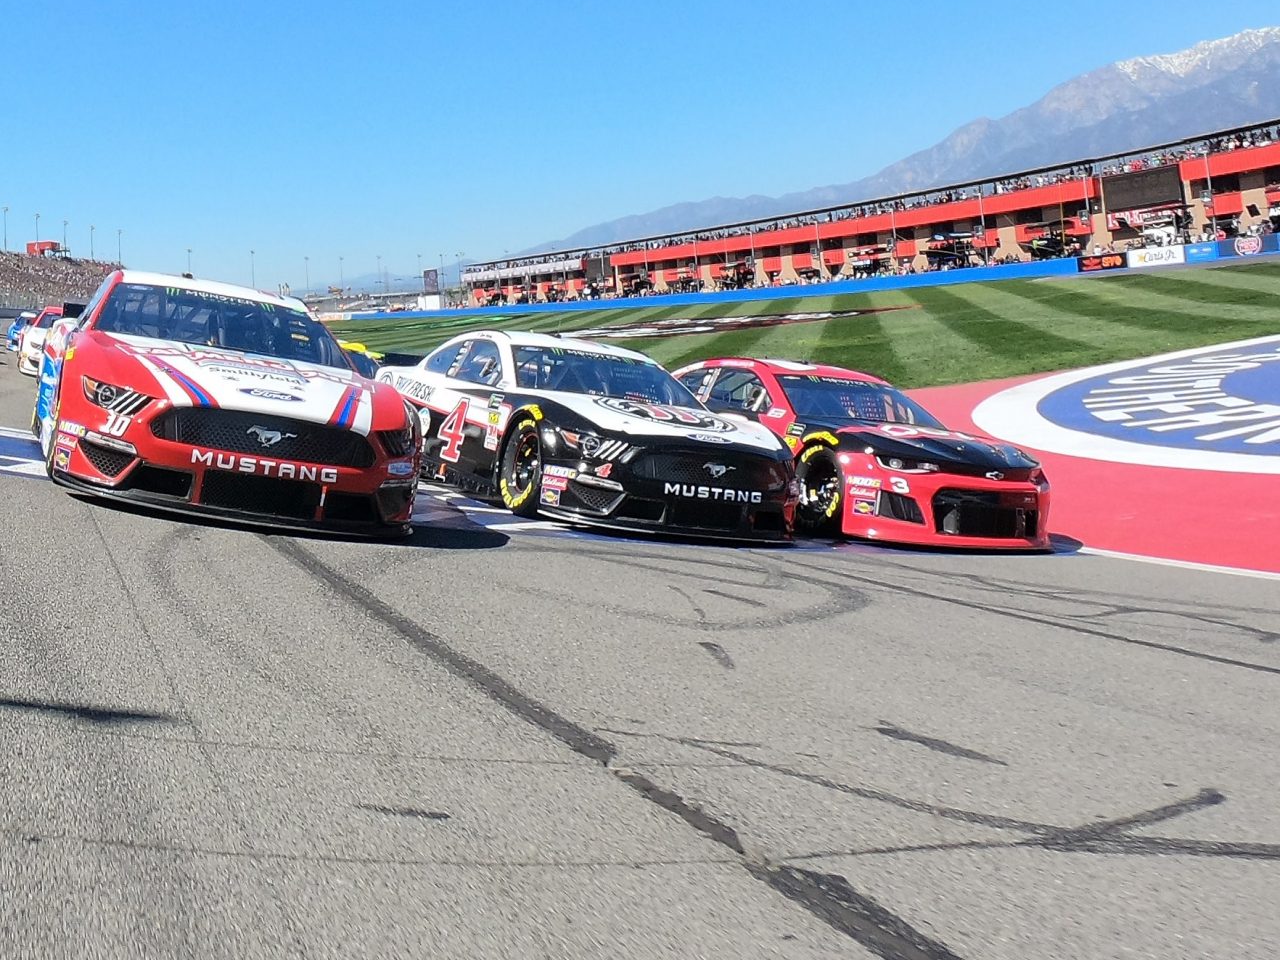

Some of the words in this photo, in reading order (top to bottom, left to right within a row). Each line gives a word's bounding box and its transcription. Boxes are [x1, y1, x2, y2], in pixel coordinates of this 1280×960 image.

[185, 289, 257, 307] MONSTER
[209, 366, 304, 386] Smithfield
[250, 388, 294, 401] Ford
[59, 420, 86, 438] MOOG
[99, 409, 133, 438] 10
[437, 396, 471, 463] 4
[191, 449, 339, 483] MUSTANG
[544, 464, 578, 479] MOOG
[594, 463, 613, 478] 4
[846, 475, 882, 487] MOOG
[889, 476, 910, 494] 3
[663, 482, 762, 504] MUSTANG
